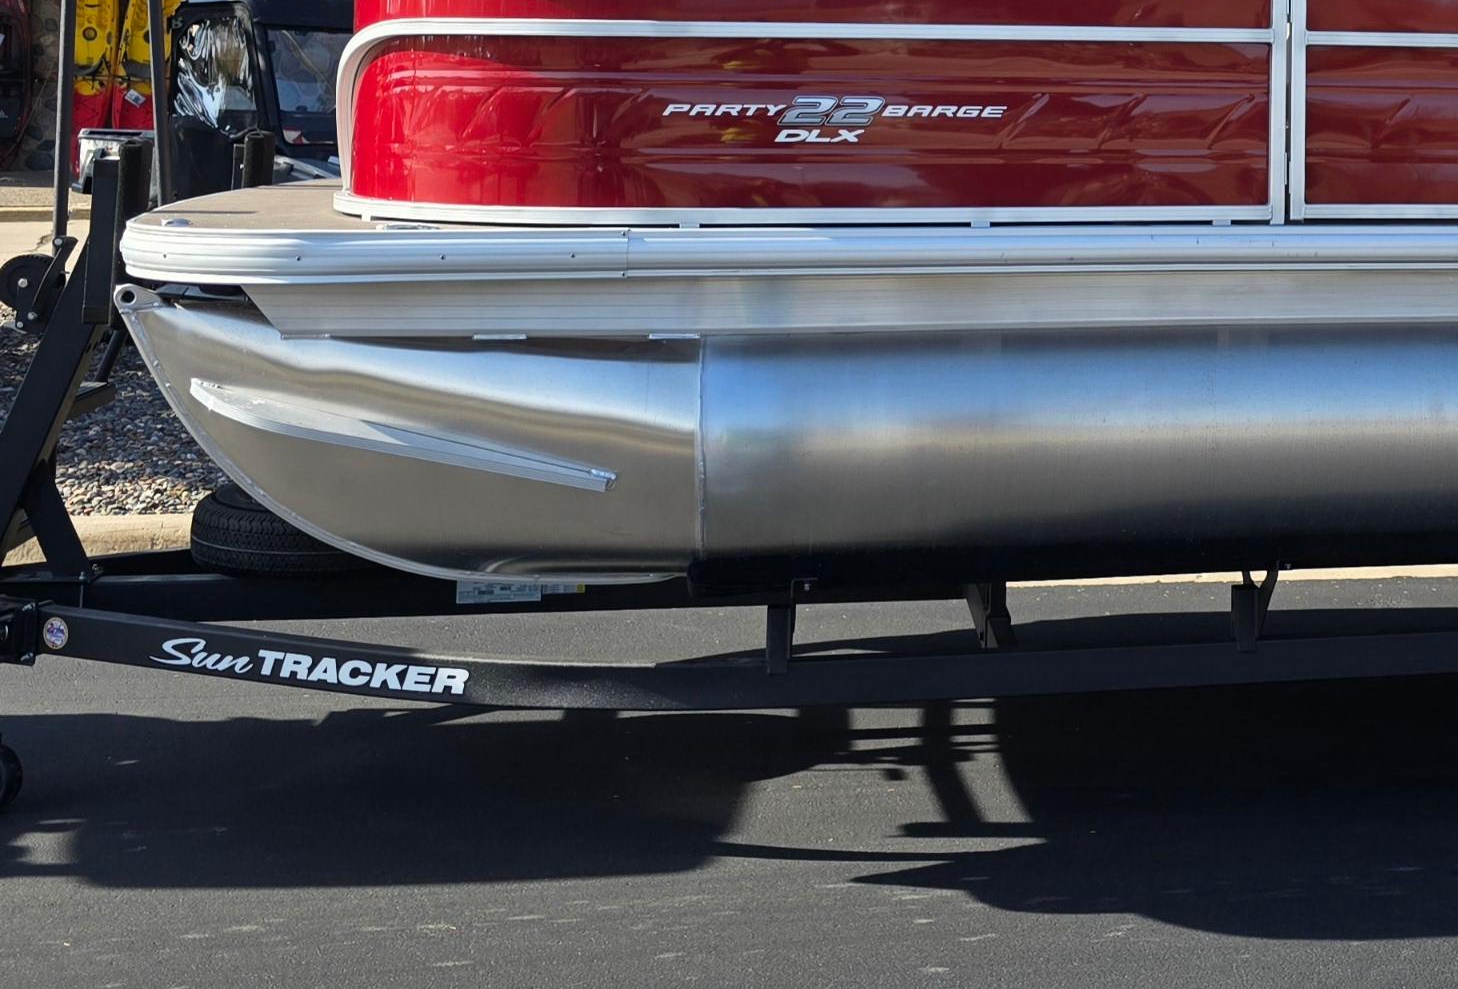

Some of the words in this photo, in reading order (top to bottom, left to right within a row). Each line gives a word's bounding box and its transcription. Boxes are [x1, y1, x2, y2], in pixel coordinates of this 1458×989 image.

[662, 104, 787, 117] PARTY
[776, 95, 886, 127] 22
[881, 105, 1007, 118] BARGE
[774, 128, 865, 143] DLX
[149, 637, 253, 673] Sun
[257, 649, 470, 695] TRACKER
